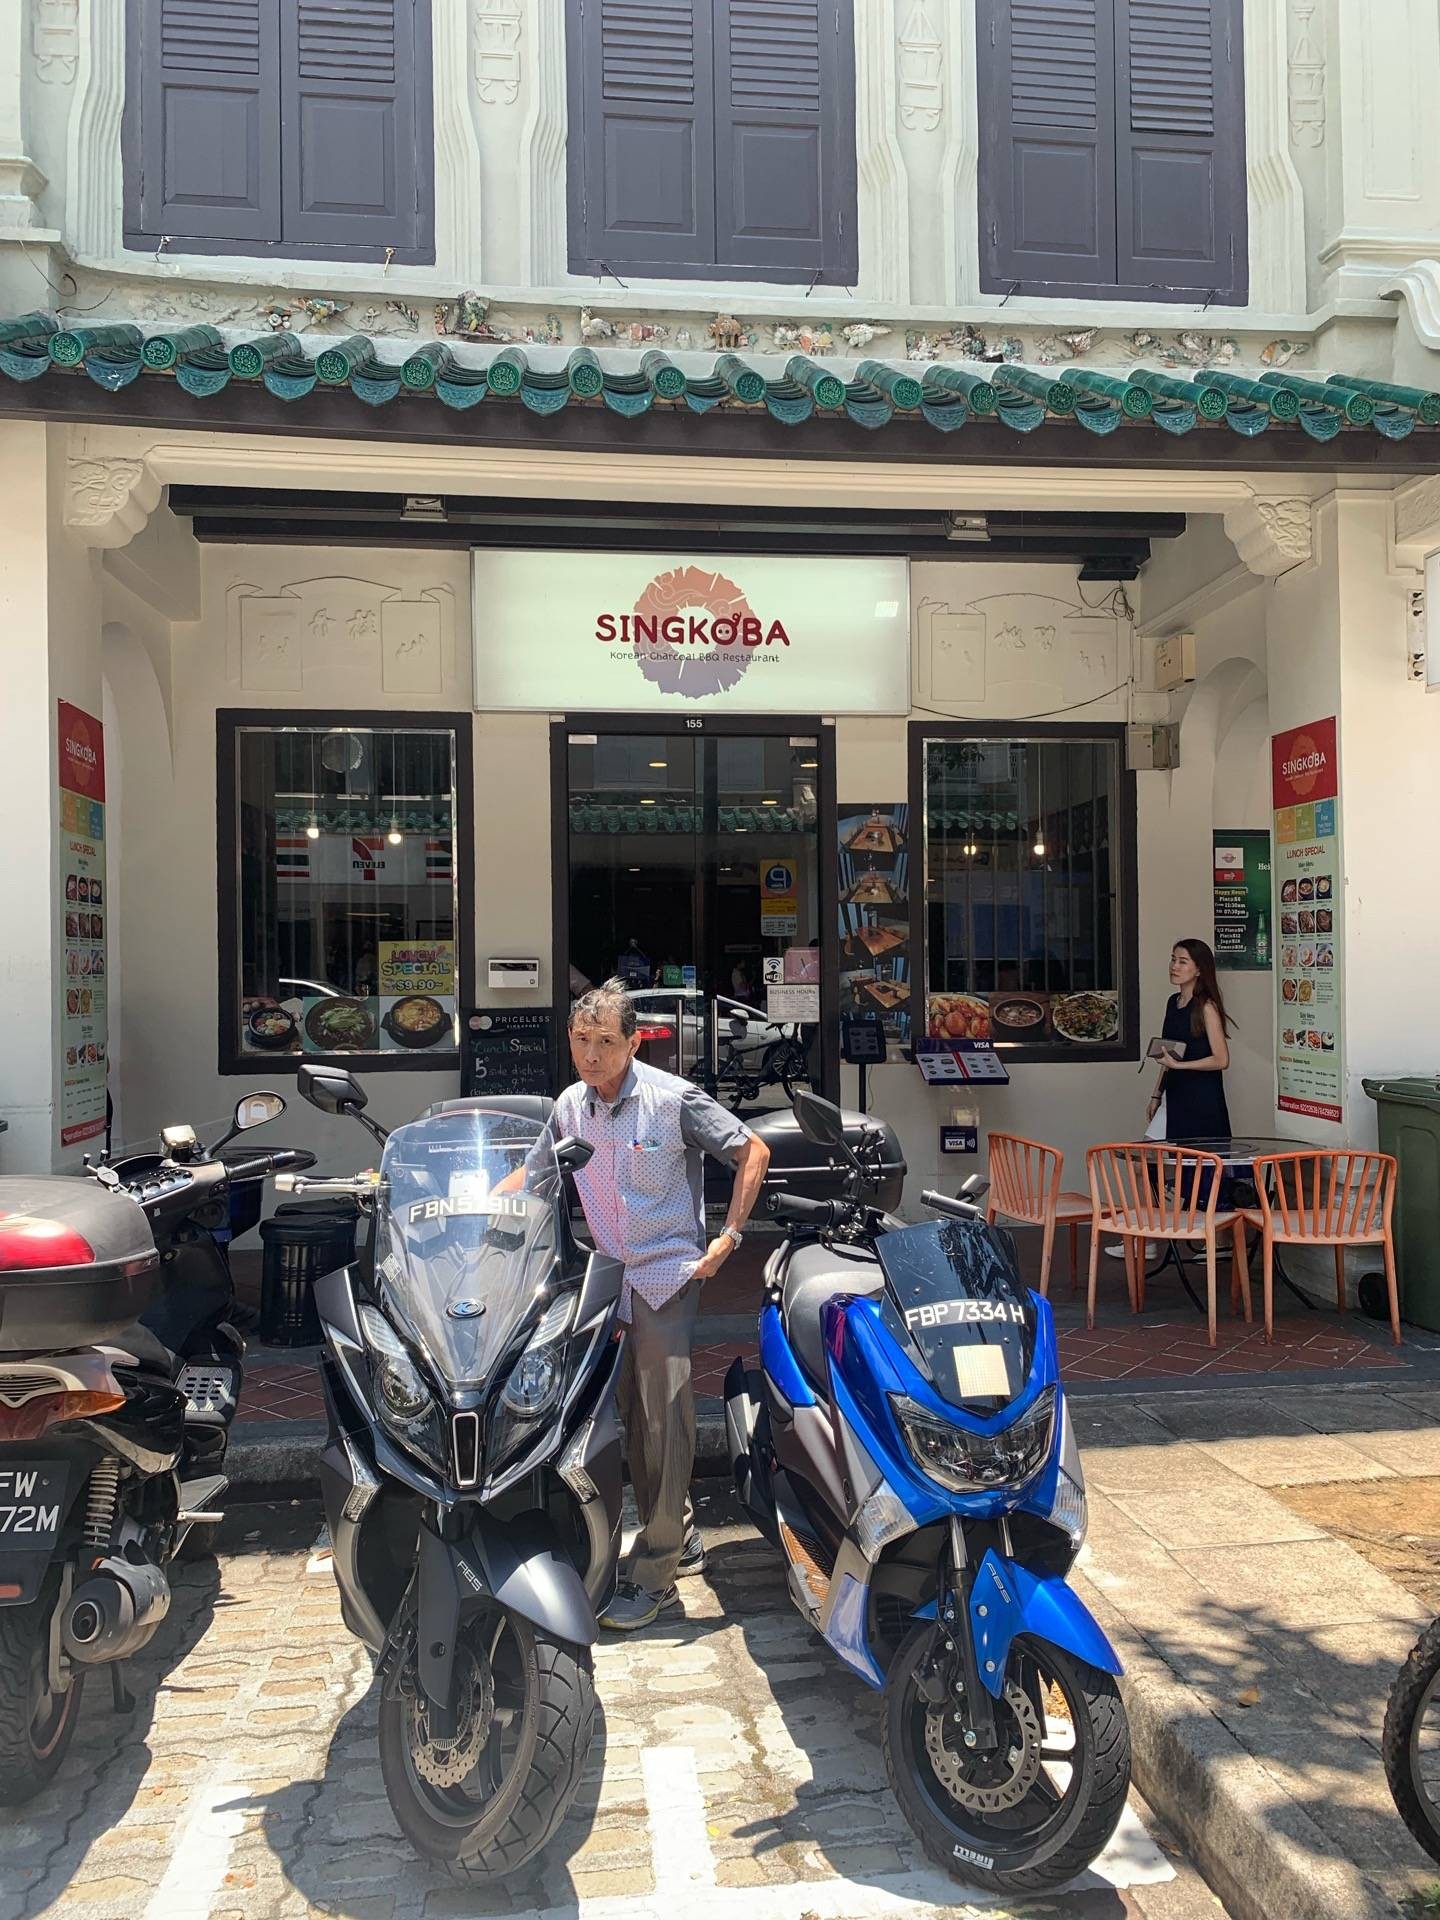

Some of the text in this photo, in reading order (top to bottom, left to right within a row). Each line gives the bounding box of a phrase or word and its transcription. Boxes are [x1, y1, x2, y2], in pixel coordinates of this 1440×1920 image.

[595, 612, 790, 647] SINGKOBA
[610, 651, 780, 663] Korean Charcoal BBQ Restaurant
[685, 719, 703, 728] 155
[1282, 751, 1327, 775] SINGKOBA
[1286, 844, 1326, 859] LUNCH SPECIAL
[391, 950, 436, 962] LUNCH
[381, 961, 450, 976] SPECIAL
[495, 1015, 550, 1023] PRICELESS
[904, 1304, 949, 1331] FBP
[949, 1301, 1008, 1322] 7334
[457, 1560, 483, 1592] ABS
[986, 1562, 1011, 1604] ABS
